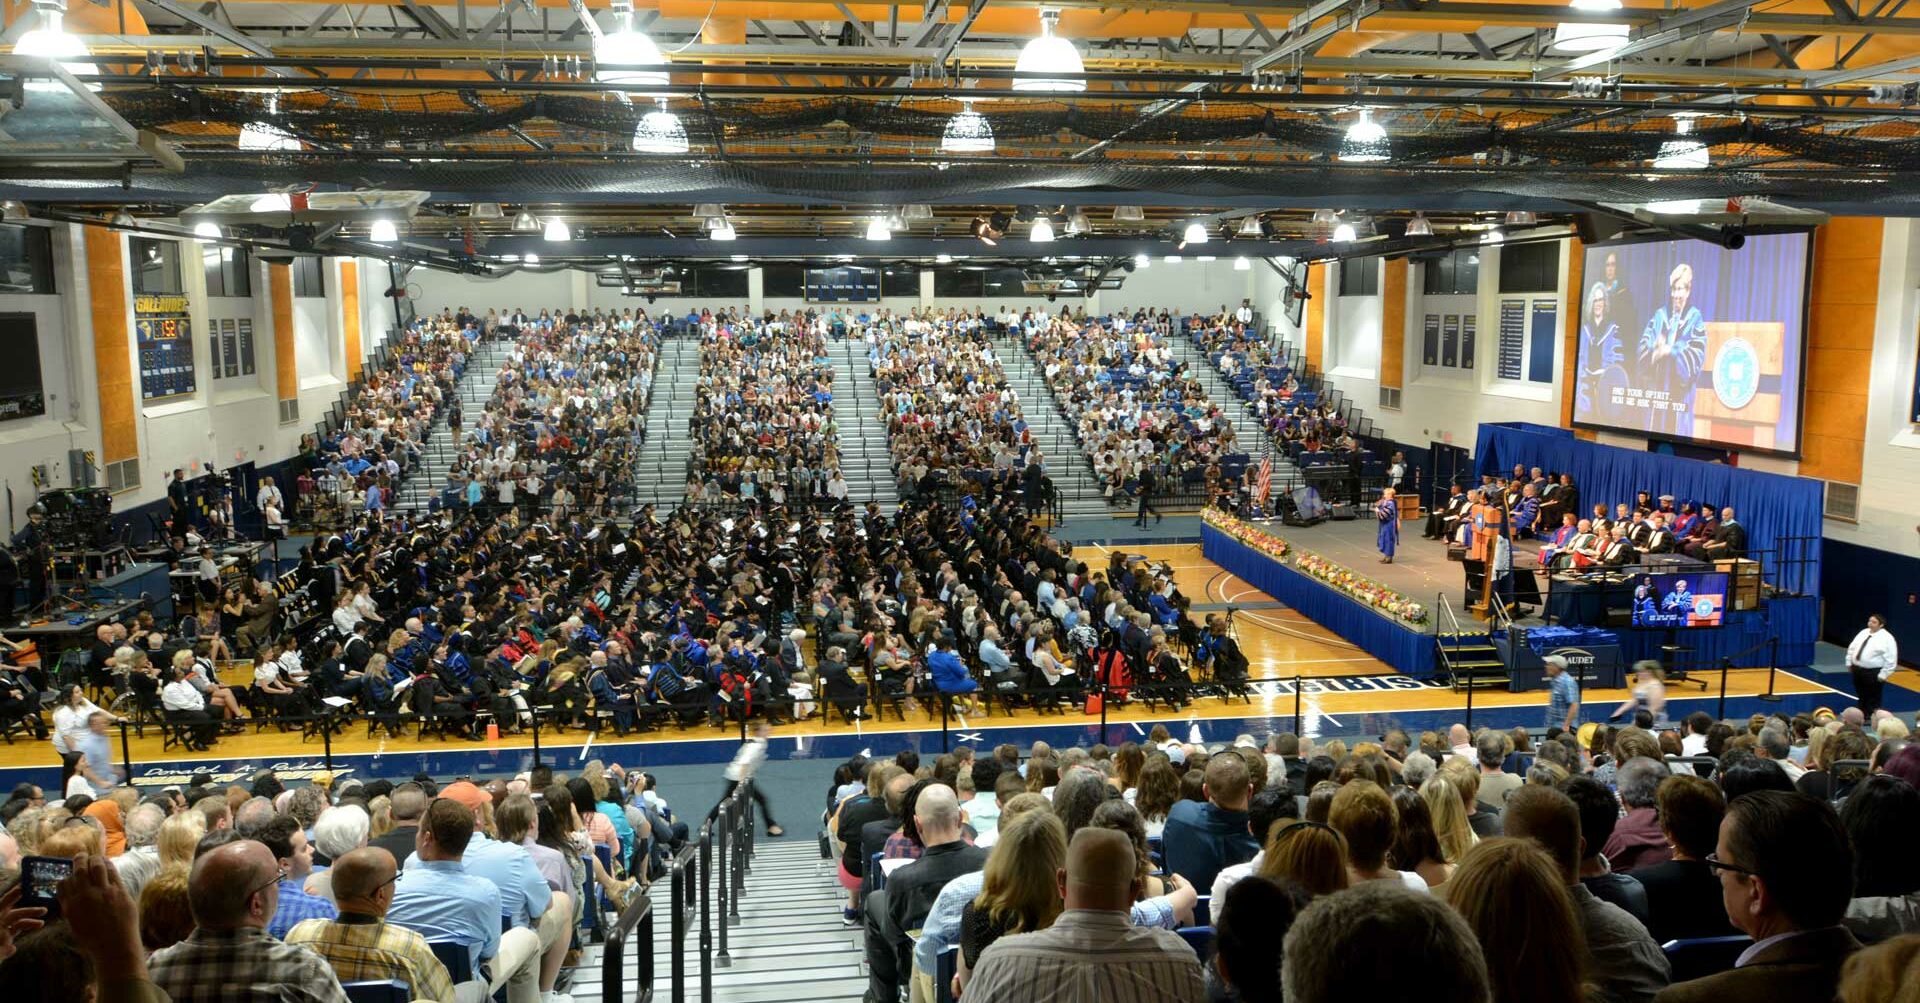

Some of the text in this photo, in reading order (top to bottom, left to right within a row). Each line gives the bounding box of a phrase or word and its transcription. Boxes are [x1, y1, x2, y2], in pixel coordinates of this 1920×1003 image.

[1627, 388, 1643, 398] YOUR
[1672, 402, 1686, 412] YOU
[1566, 656, 1596, 665] AUDET
[143, 764, 222, 777] Donald
